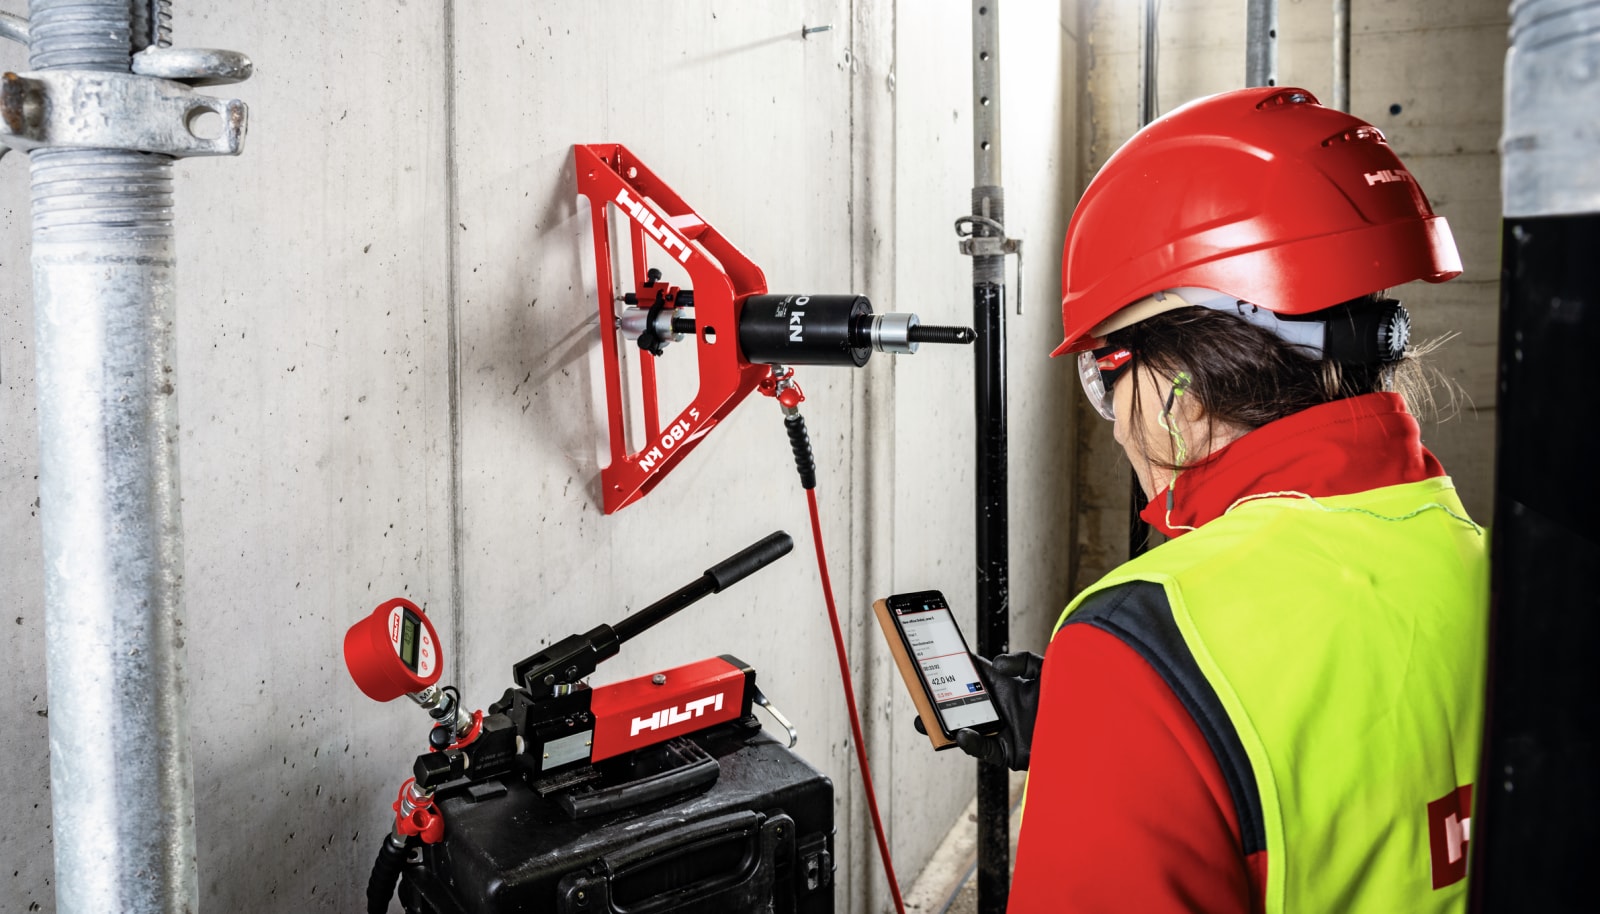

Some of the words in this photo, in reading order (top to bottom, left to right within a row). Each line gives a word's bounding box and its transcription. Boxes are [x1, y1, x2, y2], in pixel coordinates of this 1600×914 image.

[615, 187, 693, 263] HILTI
[789, 311, 805, 342] kN
[1114, 351, 1131, 361] HIL
[661, 419, 691, 449] 180
[638, 446, 664, 473] kN
[392, 613, 400, 643] HILTI
[629, 692, 724, 737] HILTI
